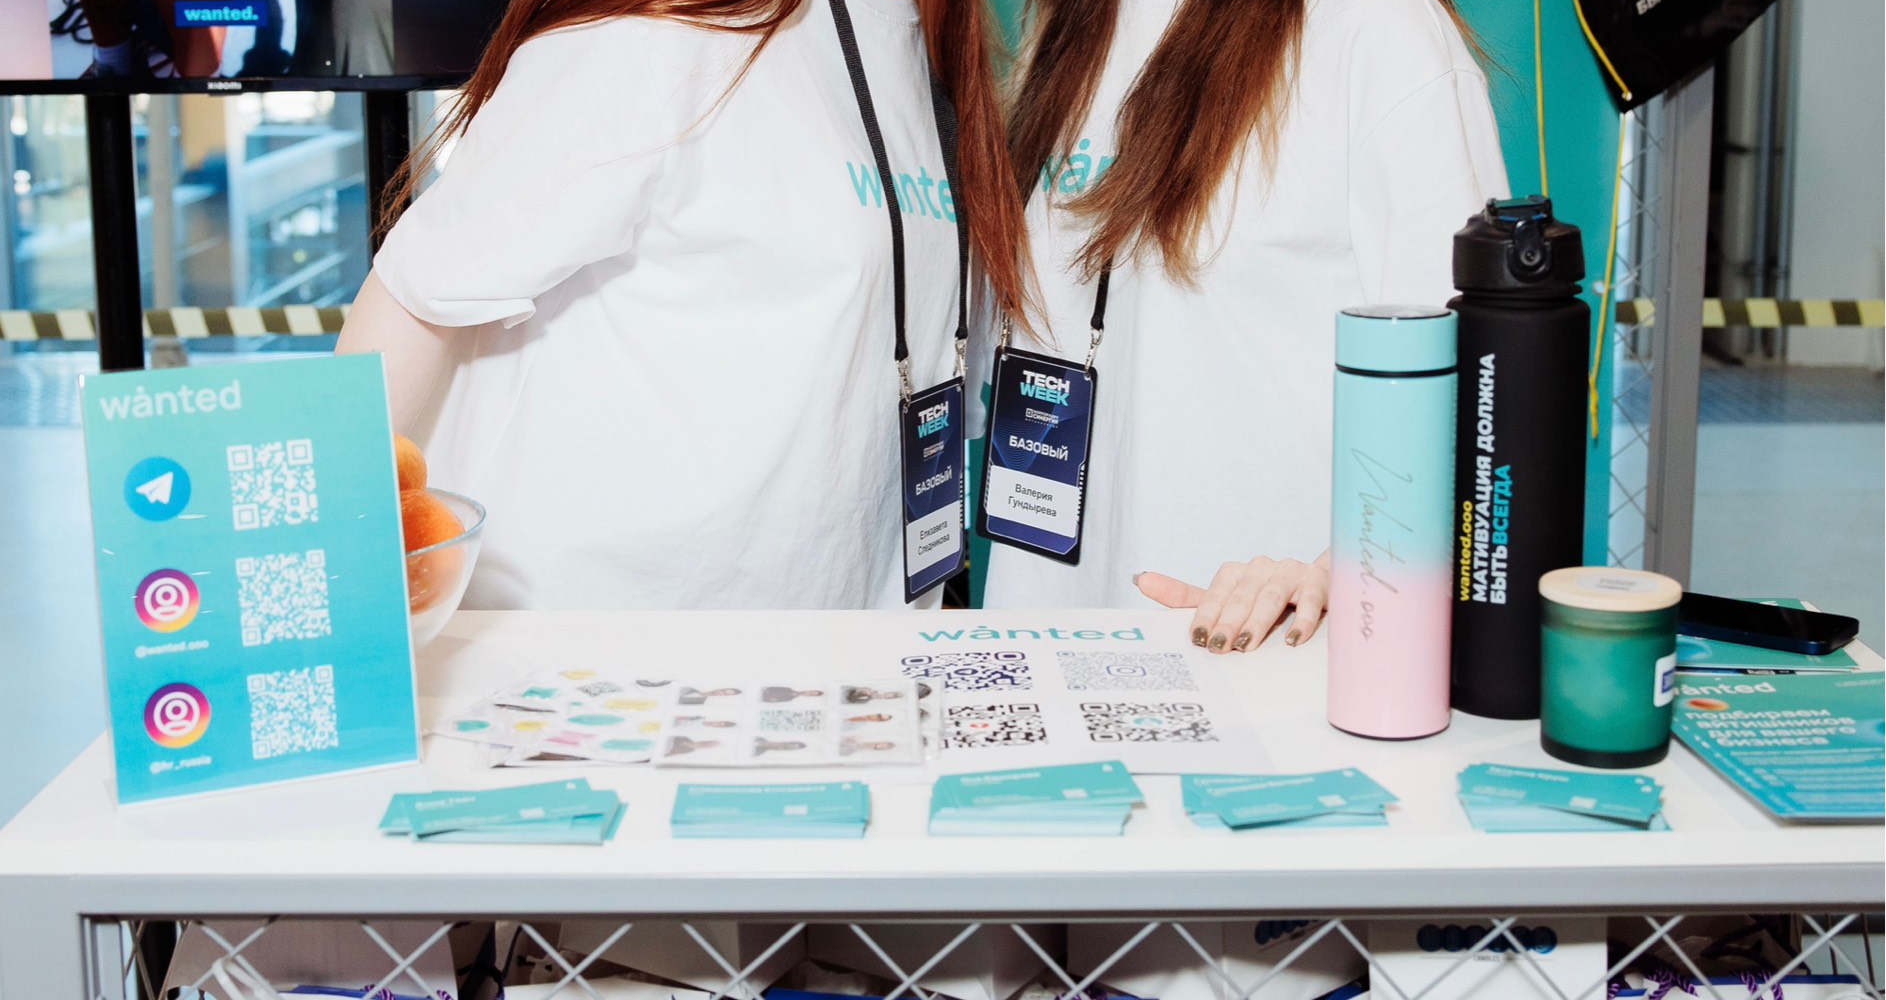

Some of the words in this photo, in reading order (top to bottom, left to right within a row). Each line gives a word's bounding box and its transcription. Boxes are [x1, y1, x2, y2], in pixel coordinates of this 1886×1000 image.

[184, 5, 259, 21] wanted.
[1022, 370, 1071, 393] TECH
[1020, 382, 1069, 406] WEEK
[1476, 353, 1496, 453] ДОЛЖНА
[918, 401, 949, 420] TECH
[917, 414, 949, 438] WEEK
[1009, 435, 1068, 461] БАЗОВЫЙ
[915, 465, 952, 496] БАЗОВЫЙ
[1015, 483, 1053, 503] Валерия
[1492, 464, 1513, 545] ВСЕГДА
[1008, 496, 1057, 518] Гундырева
[1472, 455, 1492, 602] МАТИВУАЦИЯ
[1460, 500, 1473, 601] wanted.ooo
[1490, 545, 1508, 605] БЫТЬ
[1685, 709, 1831, 721] подбираем
[1708, 729, 1757, 738] для
[1760, 726, 1857, 738] вашего
[1715, 736, 1830, 747] бизнеса
